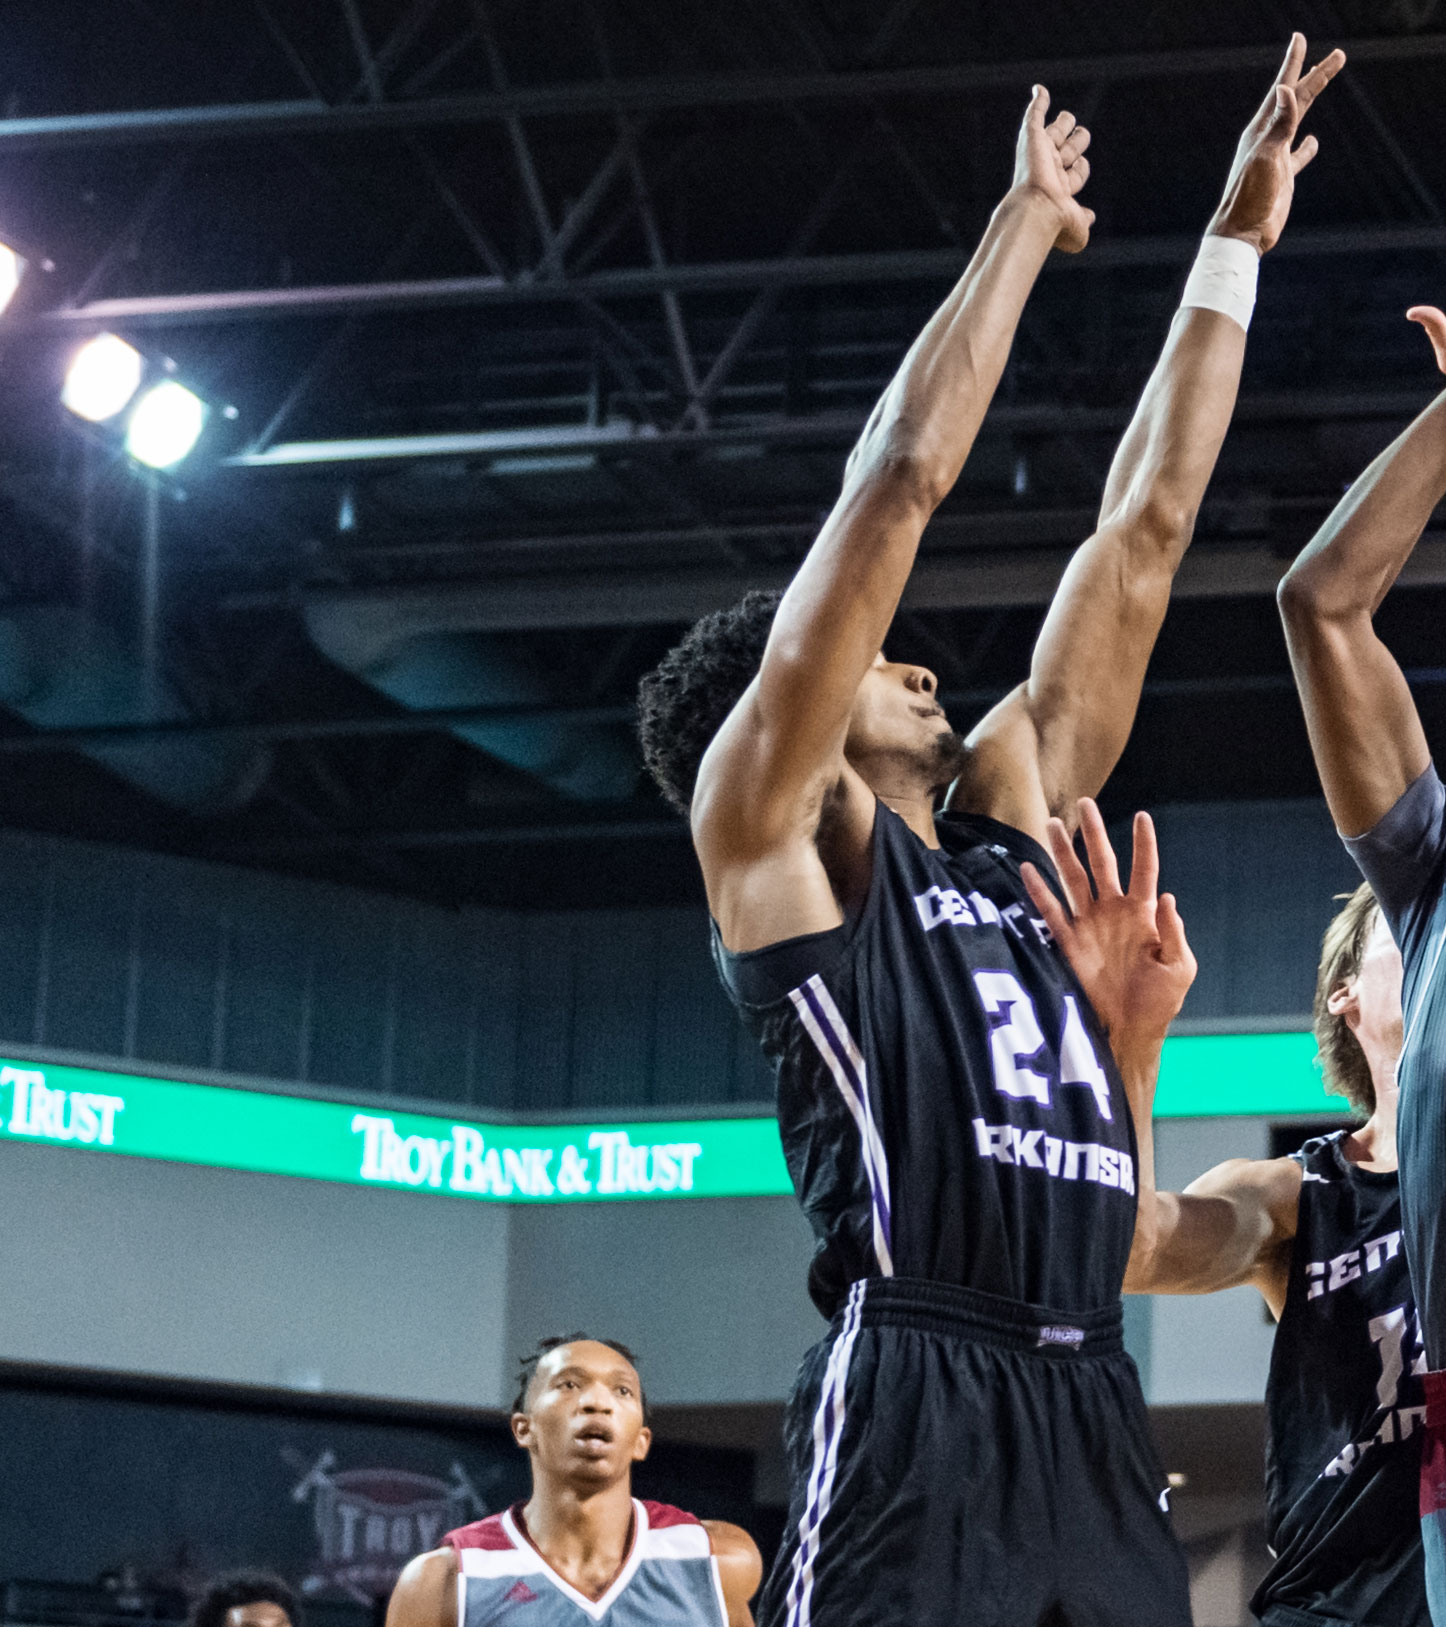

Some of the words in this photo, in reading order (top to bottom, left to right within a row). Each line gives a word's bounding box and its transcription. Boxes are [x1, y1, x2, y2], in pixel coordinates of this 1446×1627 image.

[973, 967, 1114, 1124] 24
[557, 1145, 593, 1195] &
[1368, 1303, 1428, 1410] 1
